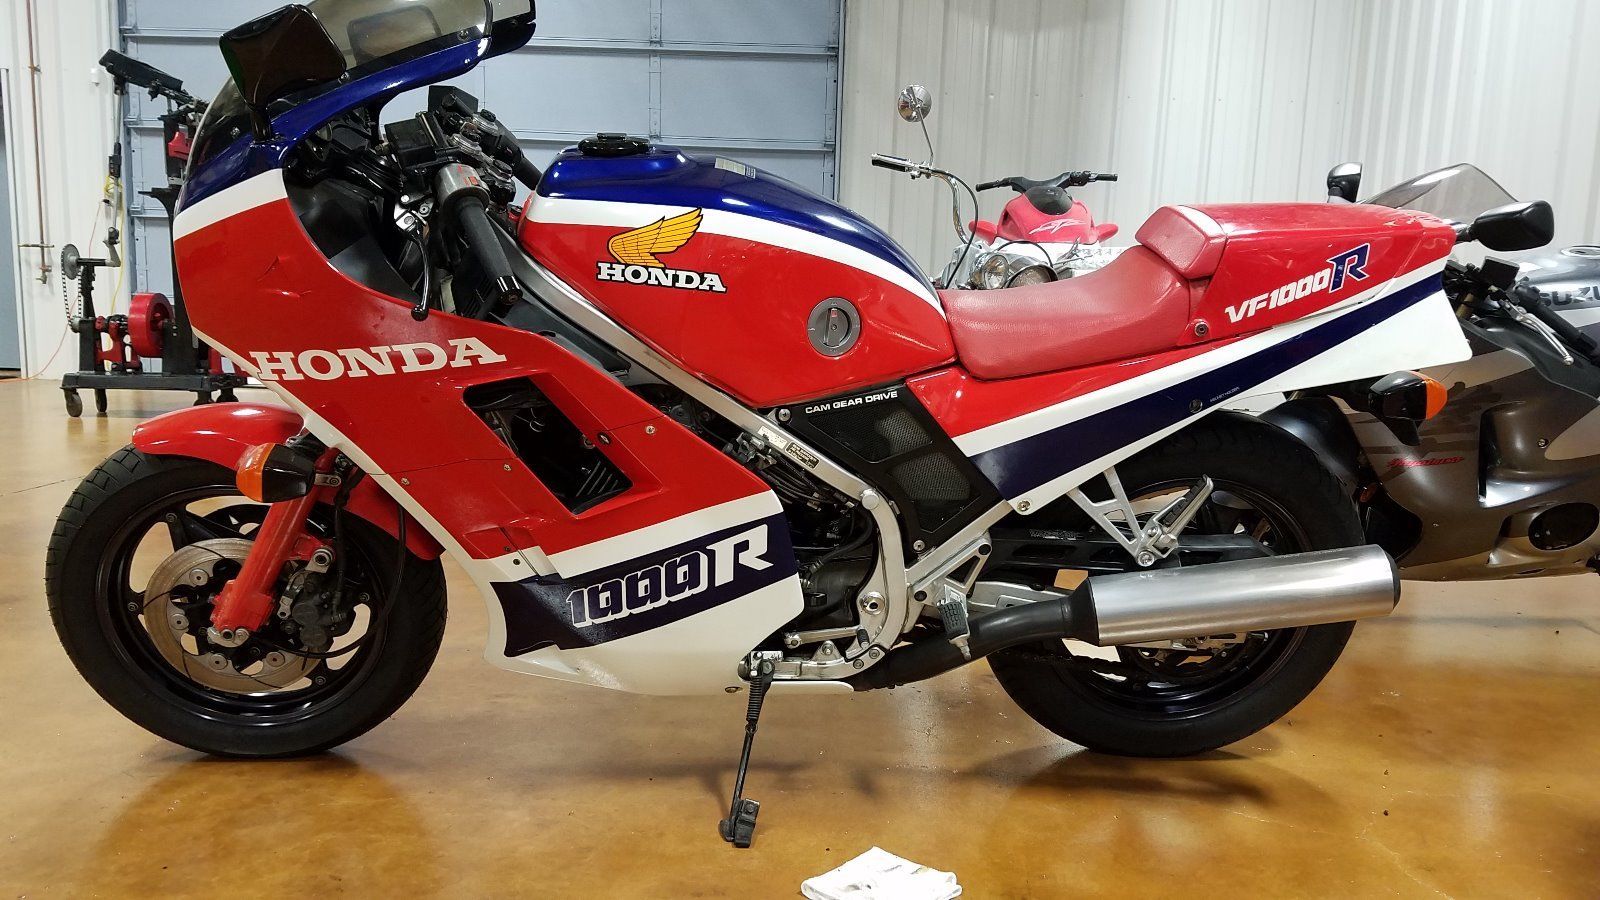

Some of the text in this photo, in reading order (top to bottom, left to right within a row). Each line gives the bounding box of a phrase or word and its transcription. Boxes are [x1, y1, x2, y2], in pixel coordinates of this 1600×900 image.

[597, 262, 727, 292] HONDA
[1225, 242, 1371, 324] VF1000R
[249, 336, 507, 381] HONDA
[805, 391, 898, 414] CAM GEAR DRIVE
[566, 523, 774, 628] 1000R
